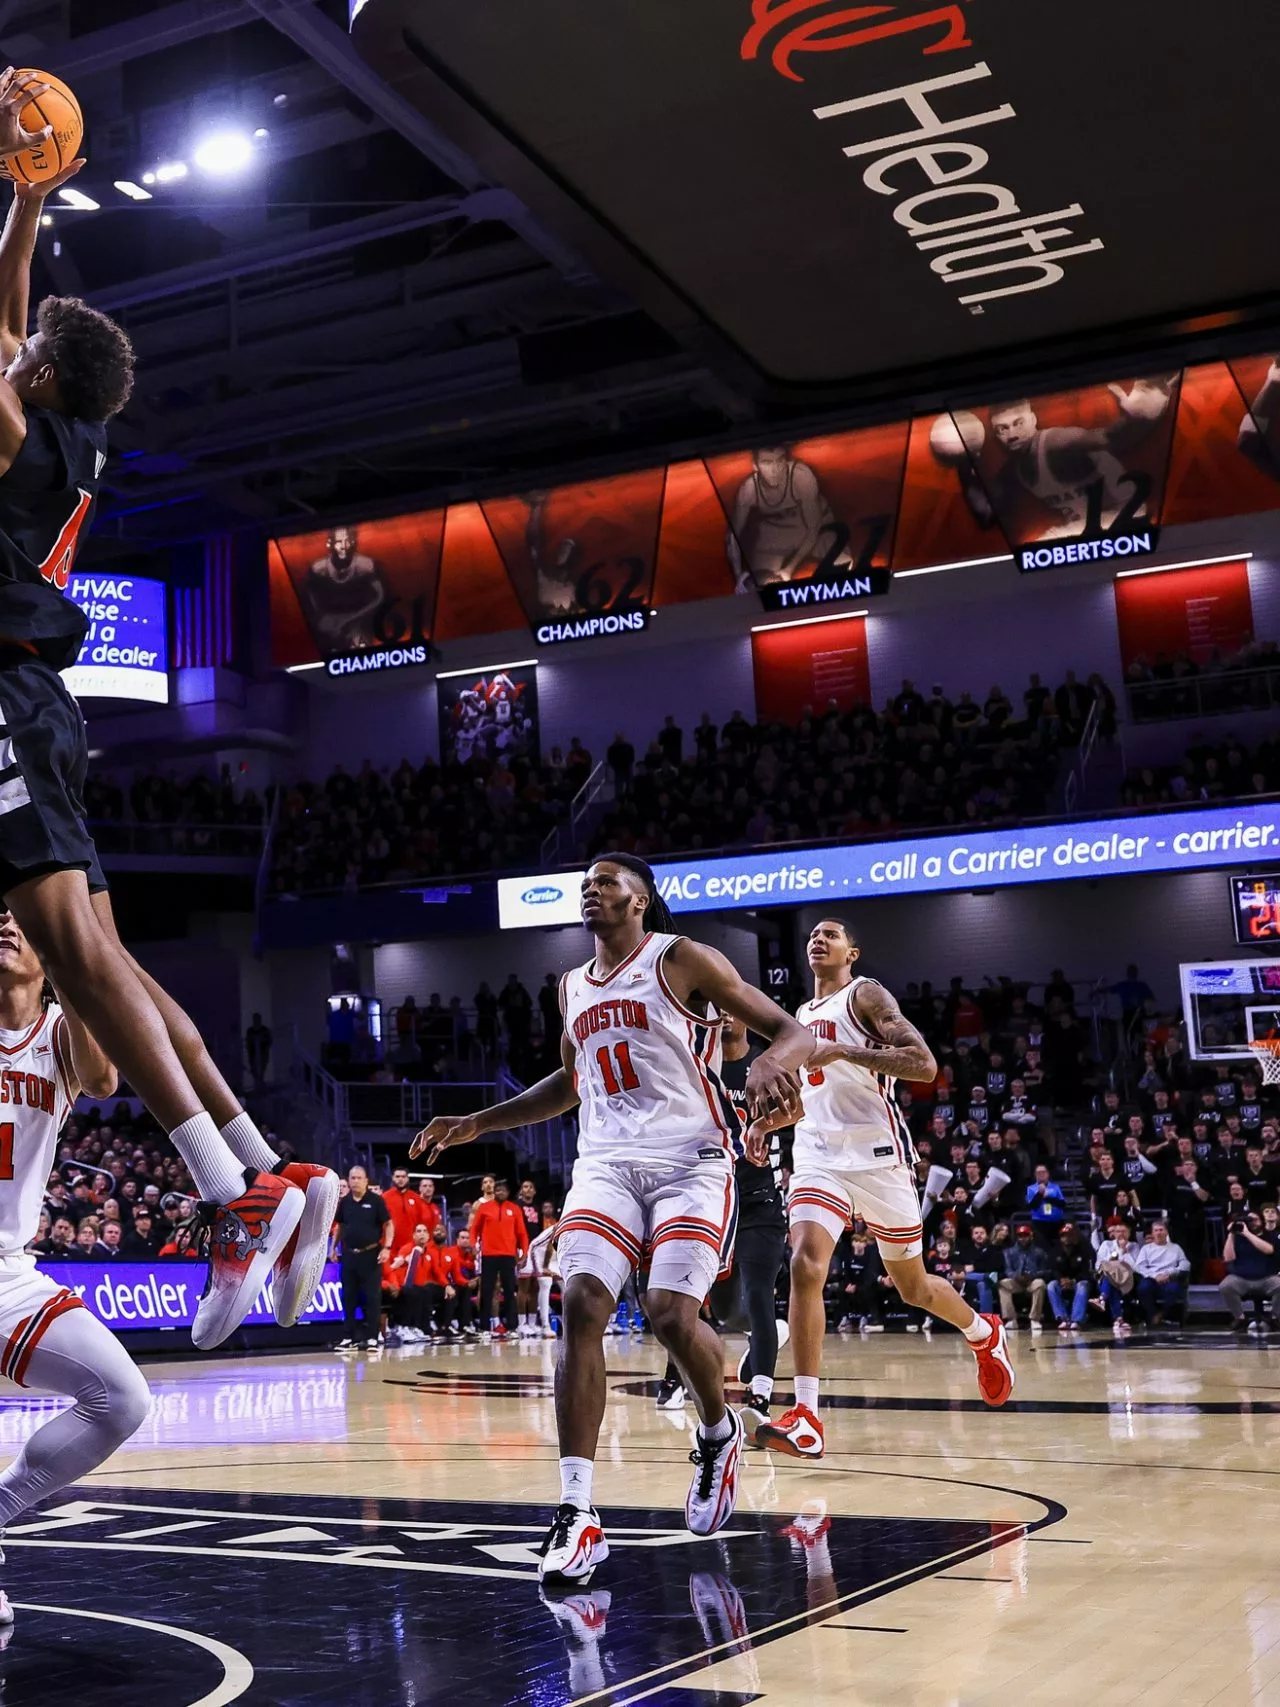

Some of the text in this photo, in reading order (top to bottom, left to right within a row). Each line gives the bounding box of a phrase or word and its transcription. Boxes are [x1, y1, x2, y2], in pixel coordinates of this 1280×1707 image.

[812, 61, 1105, 304] Health
[1079, 470, 1151, 536] 12
[1021, 532, 1152, 570] ROBERTSON
[71, 579, 133, 601] HVAC
[778, 575, 872, 607] TWYMAN
[100, 625, 116, 641] a
[536, 610, 645, 644] CHAMPIONS
[91, 643, 157, 667] dealer
[328, 645, 426, 676] CHAMPIONS
[705, 864, 824, 901] expertise
[870, 853, 917, 884] call
[922, 857, 942, 878] a
[947, 843, 1047, 876] Carrier
[1053, 833, 1149, 866] dealer
[523, 887, 560, 904] Carrier
[767, 967, 790, 985] 121
[572, 999, 650, 1050] HOUSTON
[595, 1040, 641, 1096] 11
[95, 1273, 188, 1320] dealer
